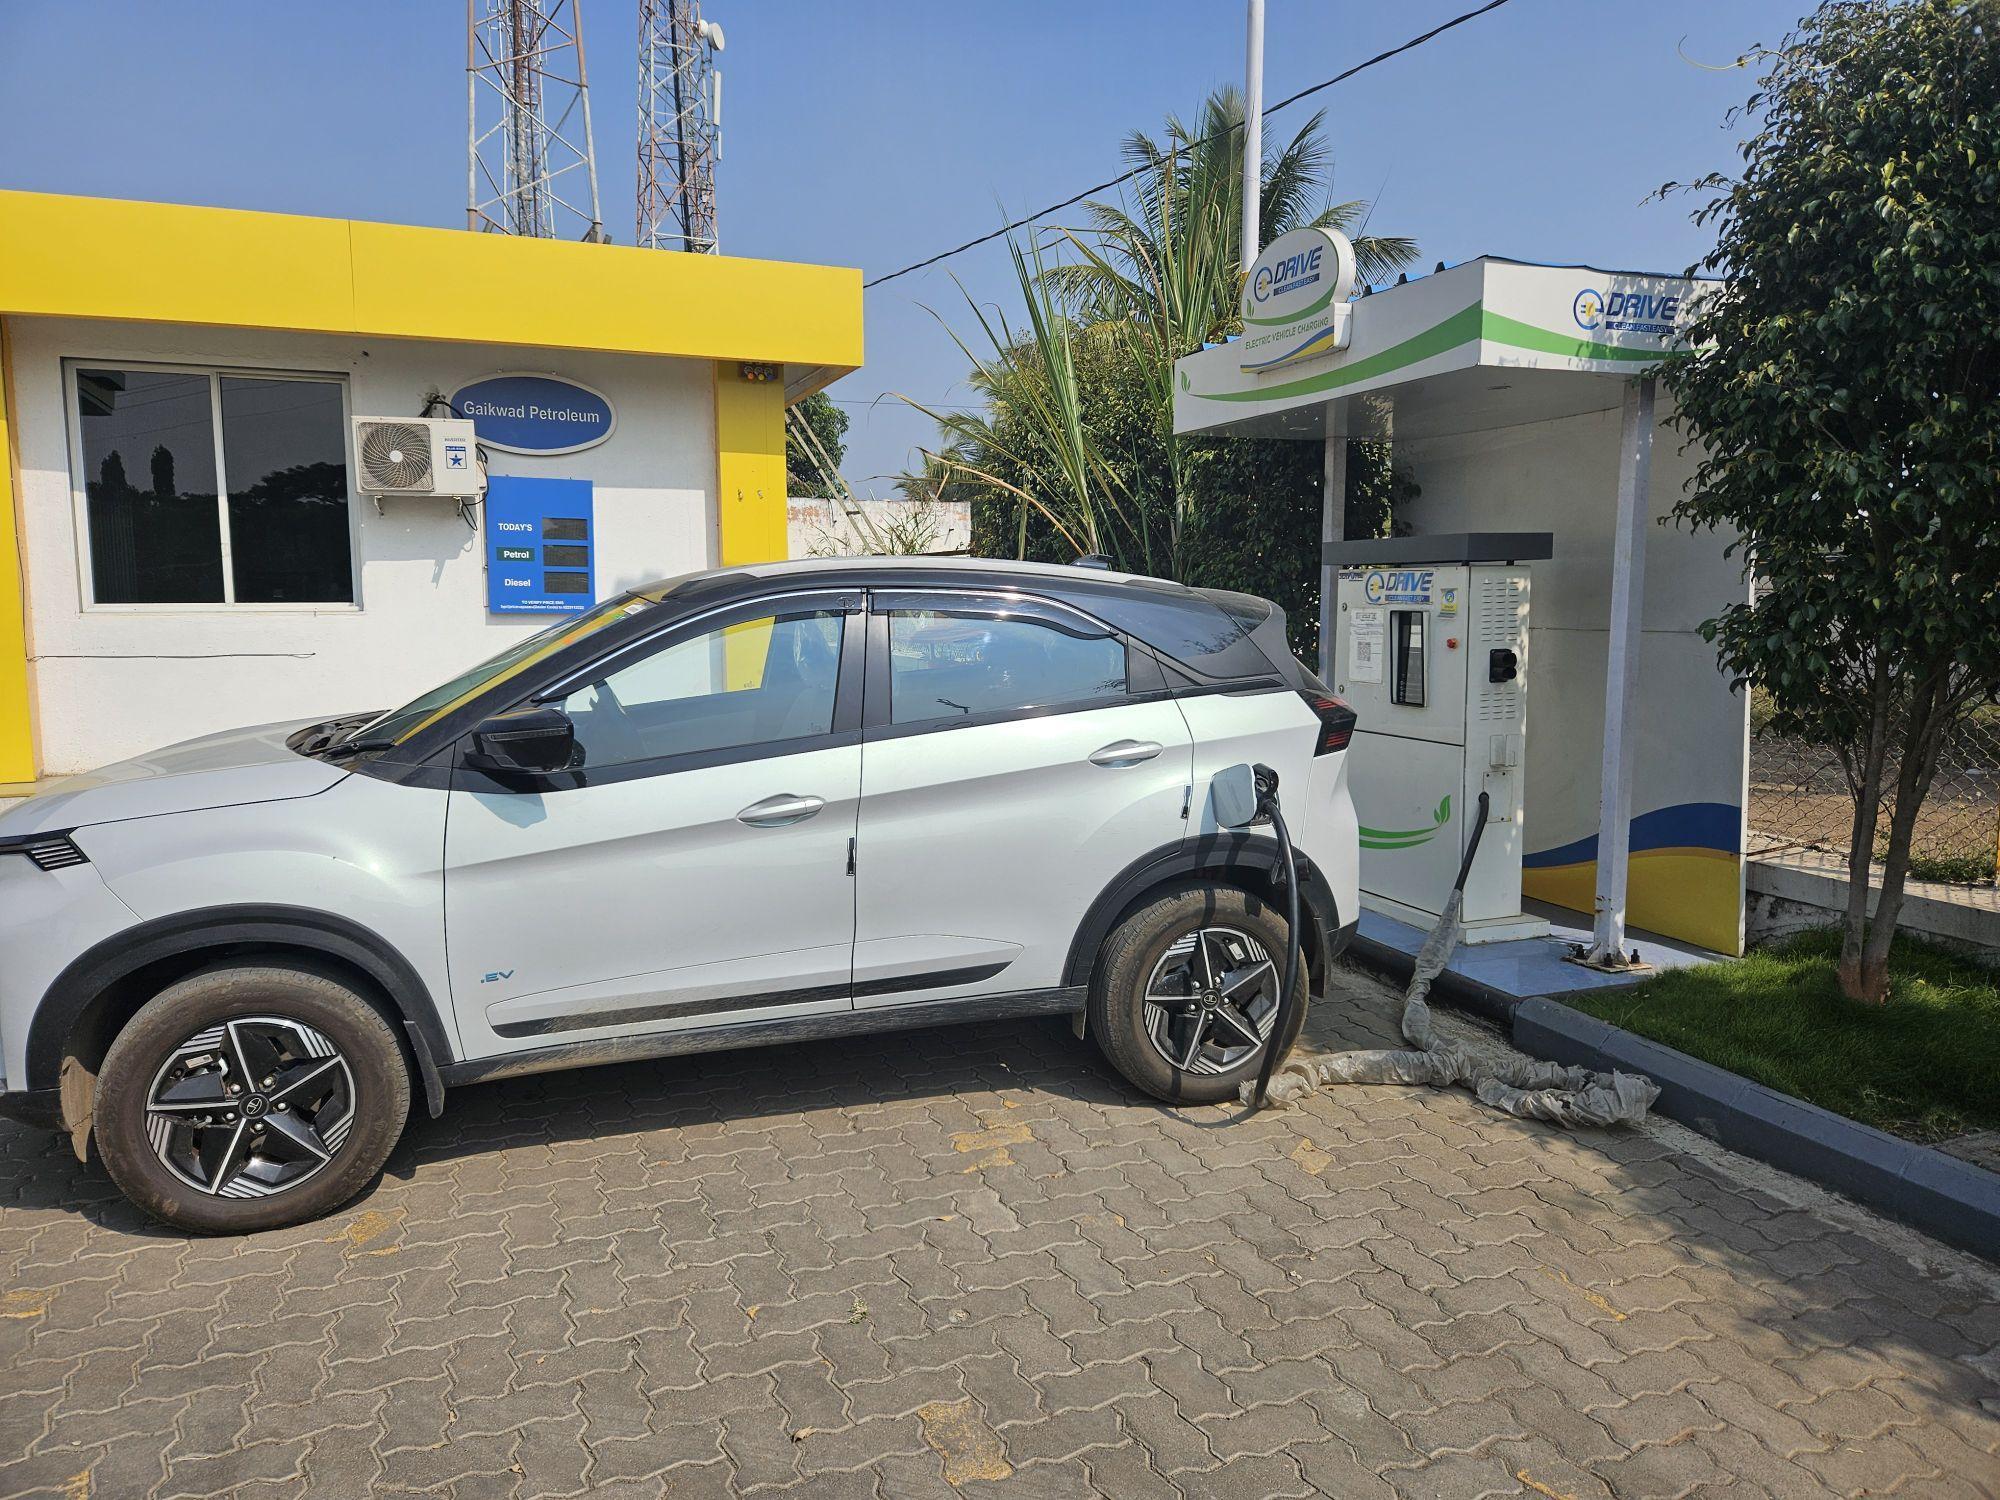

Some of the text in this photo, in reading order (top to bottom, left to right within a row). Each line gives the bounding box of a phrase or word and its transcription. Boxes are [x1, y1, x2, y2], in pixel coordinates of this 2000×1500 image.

[1245, 317, 1329, 350] ELECTRIC VEHICLE CHARGING
[463, 401, 600, 423] Gaikwad Petroleum
[498, 523, 533, 532] TODAY'S
[503, 550, 529, 559] Petrol
[504, 578, 531, 587] Diesel
